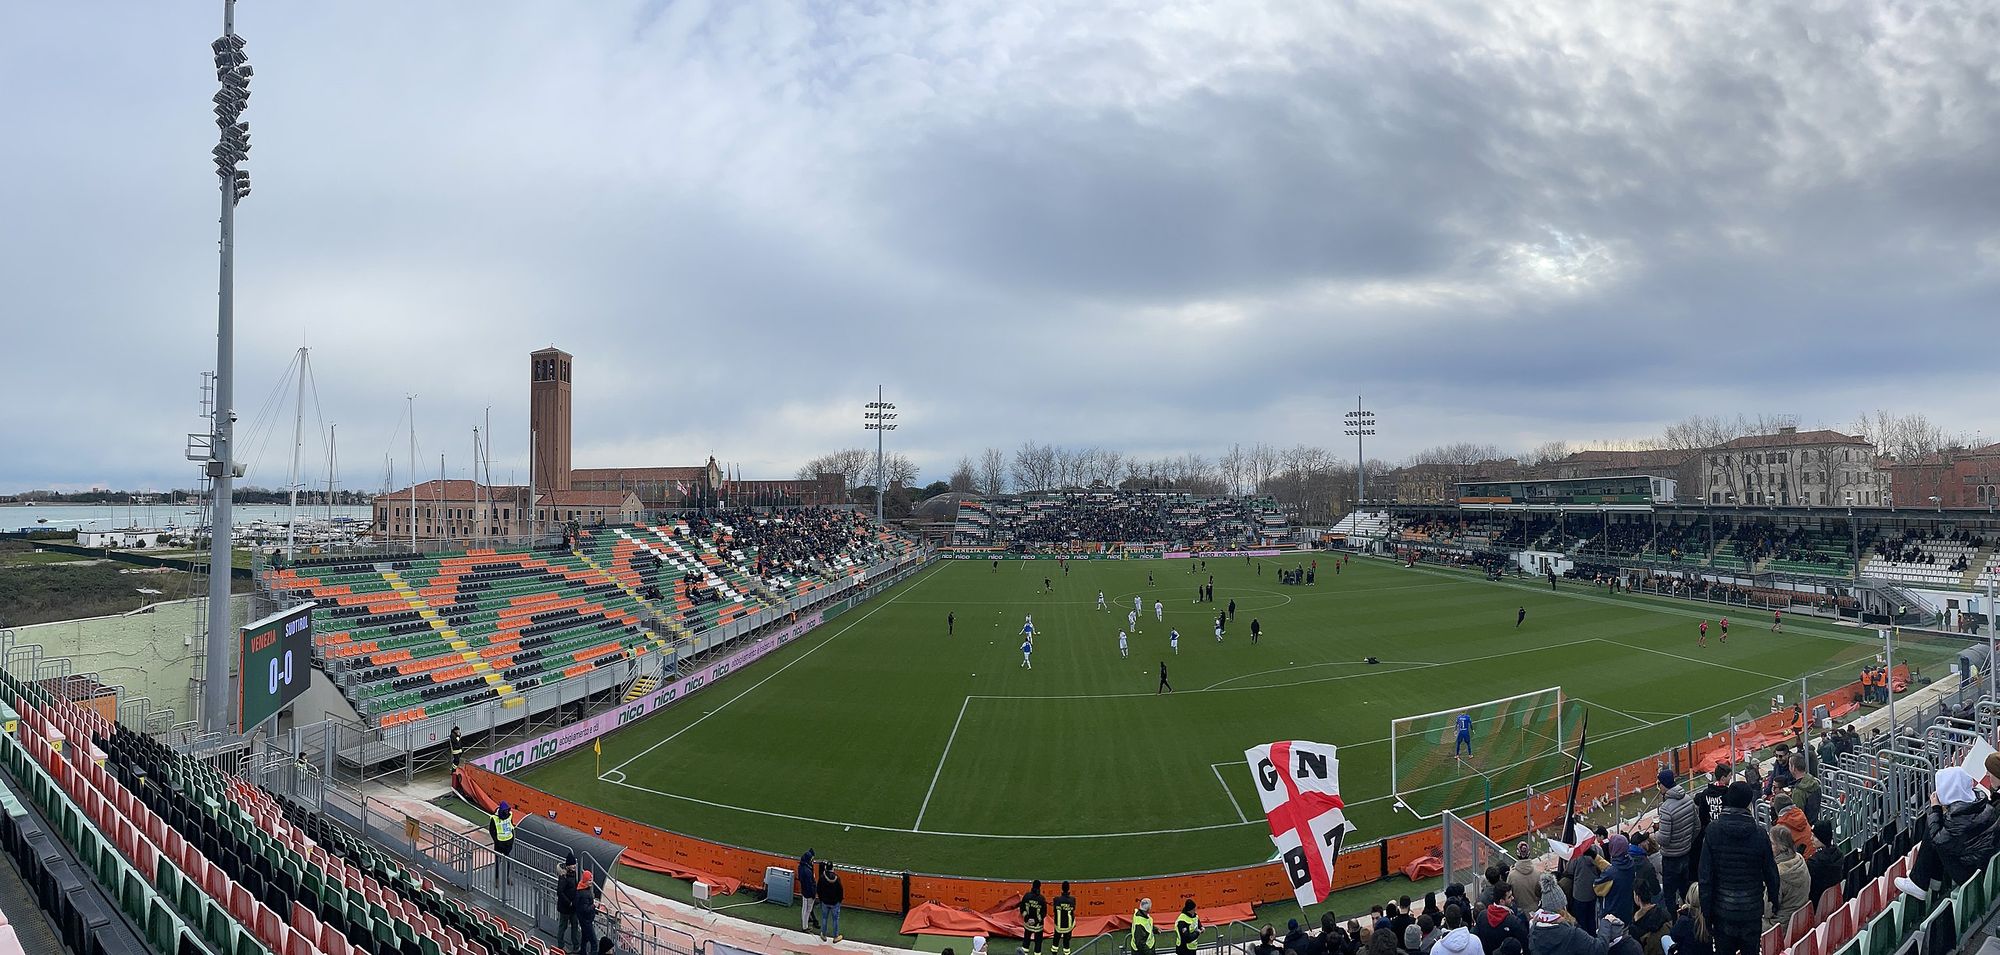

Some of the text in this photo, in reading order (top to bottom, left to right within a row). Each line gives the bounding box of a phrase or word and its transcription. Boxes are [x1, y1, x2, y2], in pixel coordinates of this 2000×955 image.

[251, 629, 277, 653] VENEZIA
[777, 633, 789, 646] nico
[712, 663, 730, 679] nico
[684, 676, 704, 693] nico
[653, 688, 676, 709] nico
[617, 704, 644, 725] nico
[559, 727, 589, 746] abbigliamento
[530, 738, 558, 762] nico
[494, 751, 525, 773] nico
[1257, 750, 1328, 791] G N
[1705, 795, 1723, 806] VANS
[1710, 804, 1723, 812] OFF
[1709, 811, 1720, 820] TH
[1284, 823, 1345, 889] B 7
